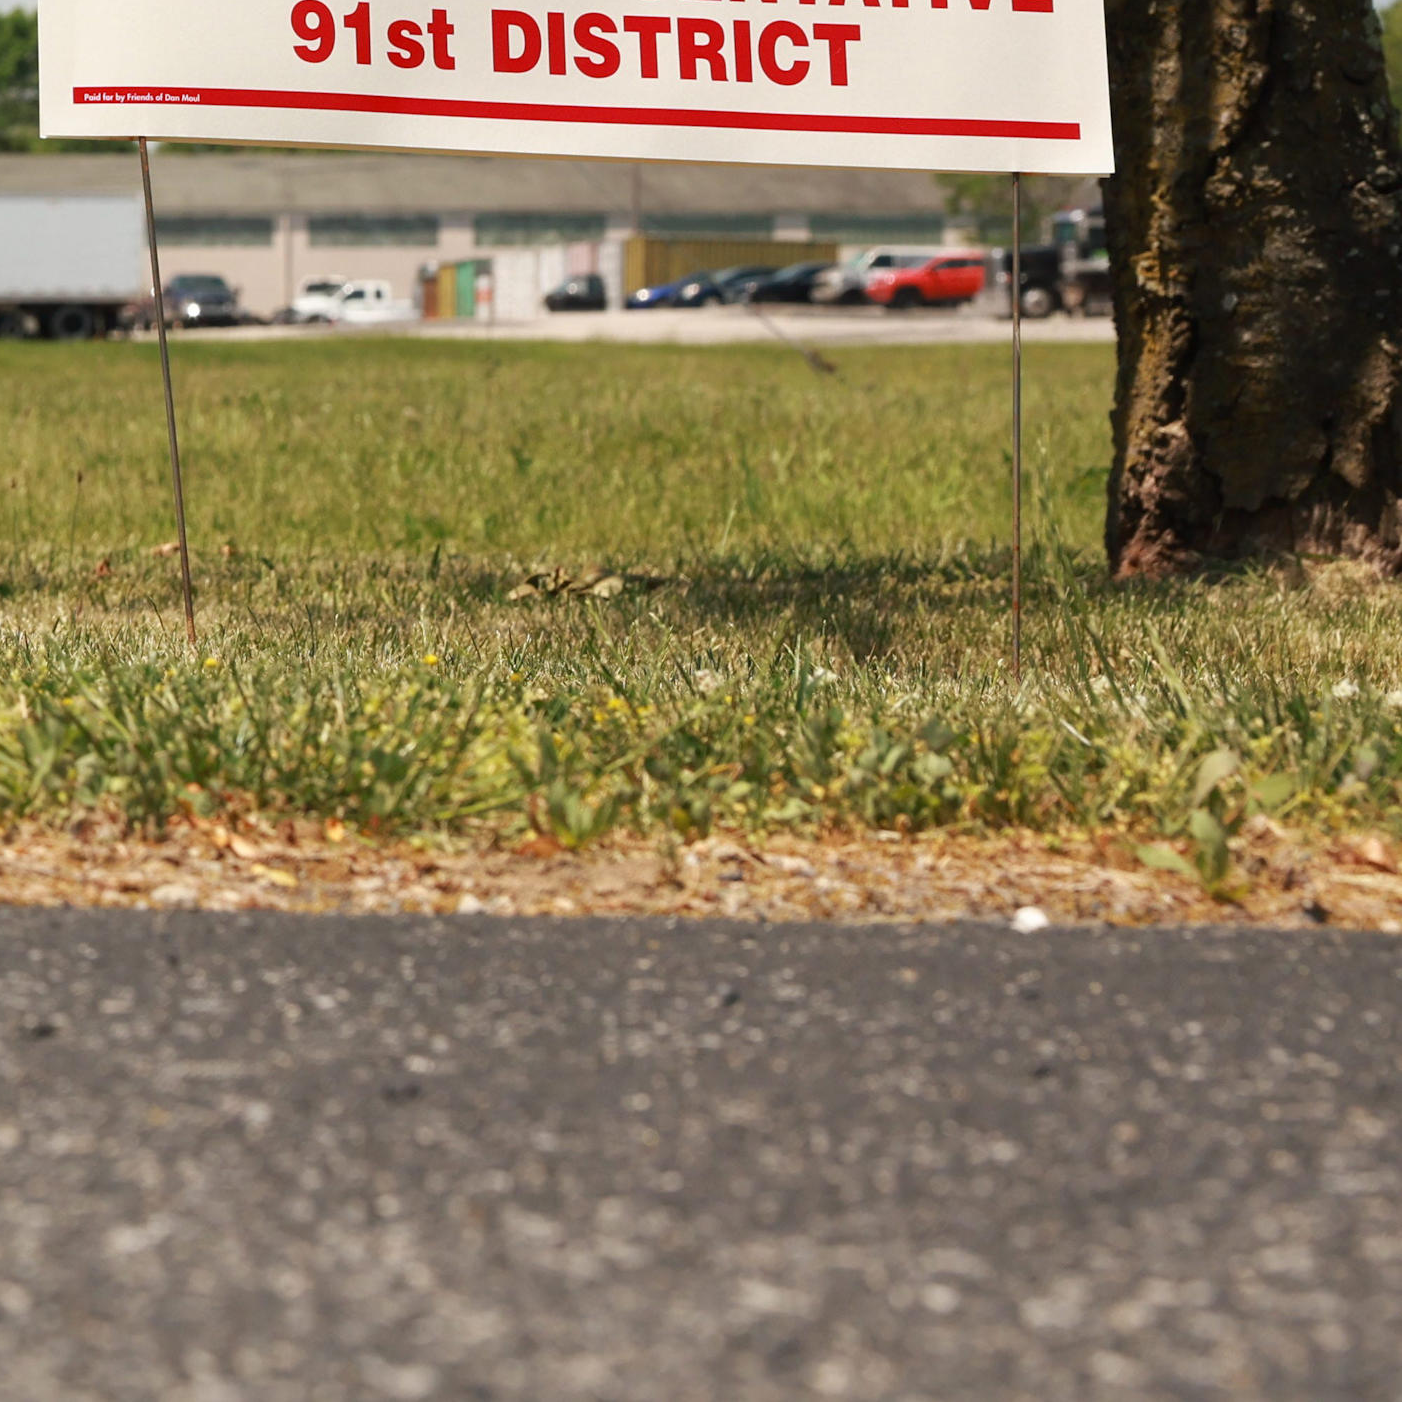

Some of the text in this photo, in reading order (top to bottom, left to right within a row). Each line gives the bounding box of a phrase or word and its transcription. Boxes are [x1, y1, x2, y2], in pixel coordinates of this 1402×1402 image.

[291, 0, 862, 86] 91st DISTRICT
[84, 93, 101, 101] Paid
[103, 93, 113, 101] for
[115, 93, 125, 103] by
[127, 93, 154, 101] Friends
[155, 93, 163, 101] of
[181, 94, 200, 102] Moul
